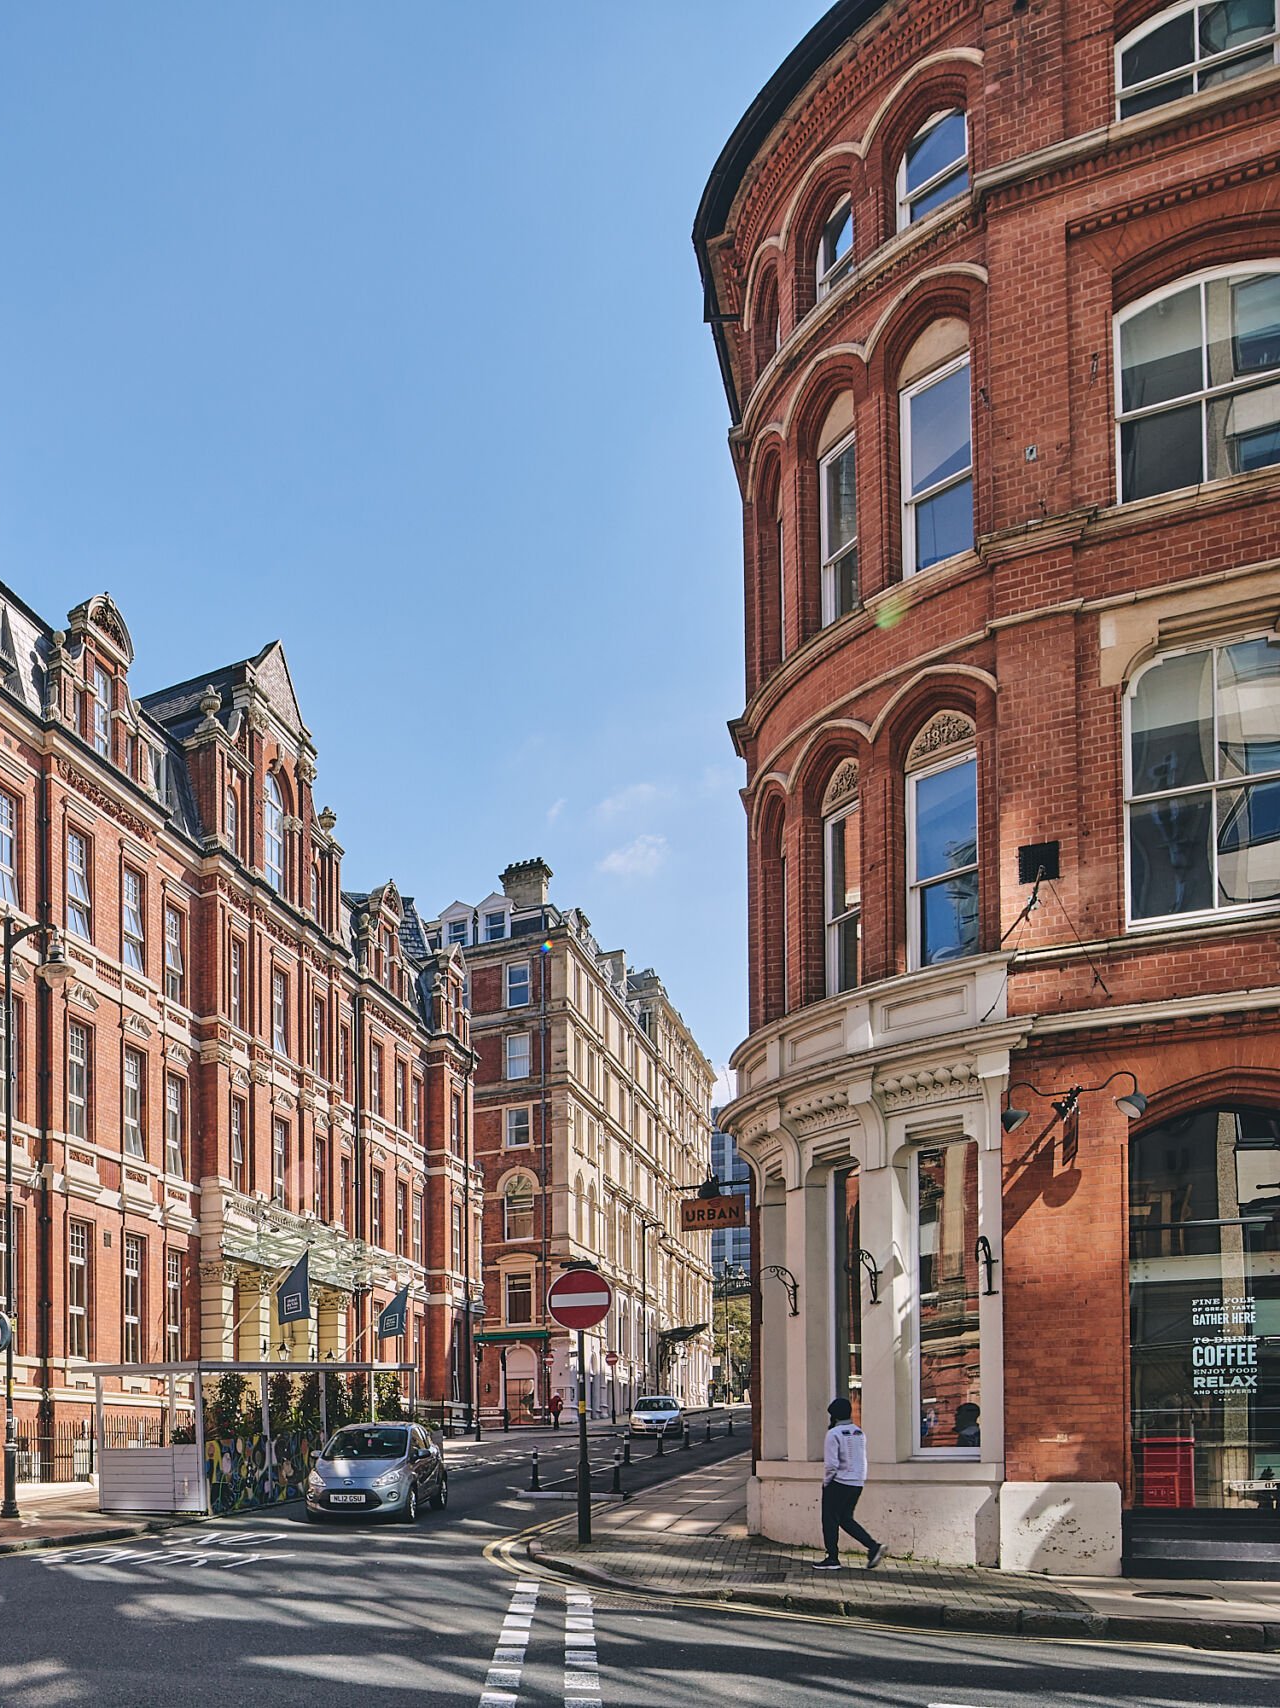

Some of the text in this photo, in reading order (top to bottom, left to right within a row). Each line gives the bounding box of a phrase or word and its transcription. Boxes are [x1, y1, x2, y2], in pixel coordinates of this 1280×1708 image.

[685, 1206, 739, 1222] URBAN
[1192, 1298, 1220, 1306] FINE
[1192, 1312, 1257, 1326] GATHER HERE
[1214, 1335, 1257, 1344] DRINK
[1192, 1344, 1258, 1367] COFFEE
[1193, 1375, 1258, 1388] RELAX
[162, 1533, 288, 1546] NO
[31, 1549, 297, 1568] ENTRY
